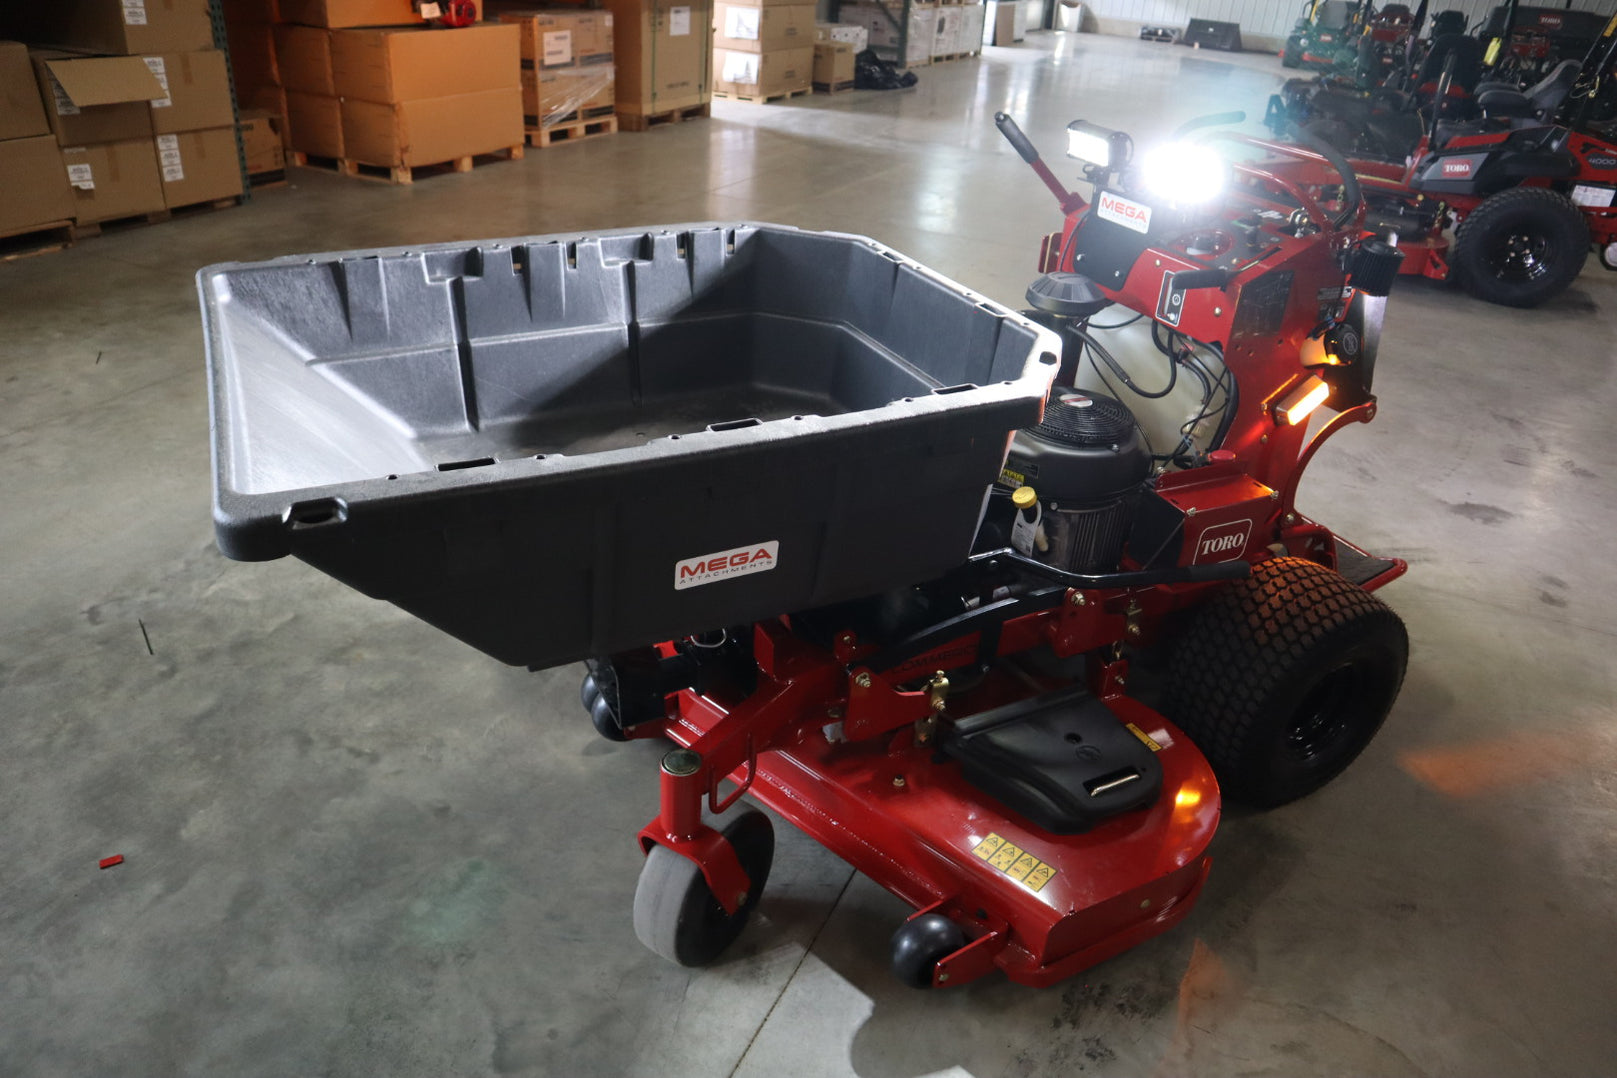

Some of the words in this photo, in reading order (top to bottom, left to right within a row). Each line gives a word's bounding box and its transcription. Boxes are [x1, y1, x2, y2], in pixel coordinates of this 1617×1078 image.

[1445, 163, 1469, 173] TORO
[1101, 197, 1147, 223] MEGA
[1203, 533, 1244, 555] TORO
[679, 560, 772, 584] ATTACHMENTS
[680, 548, 772, 578] MEGA
